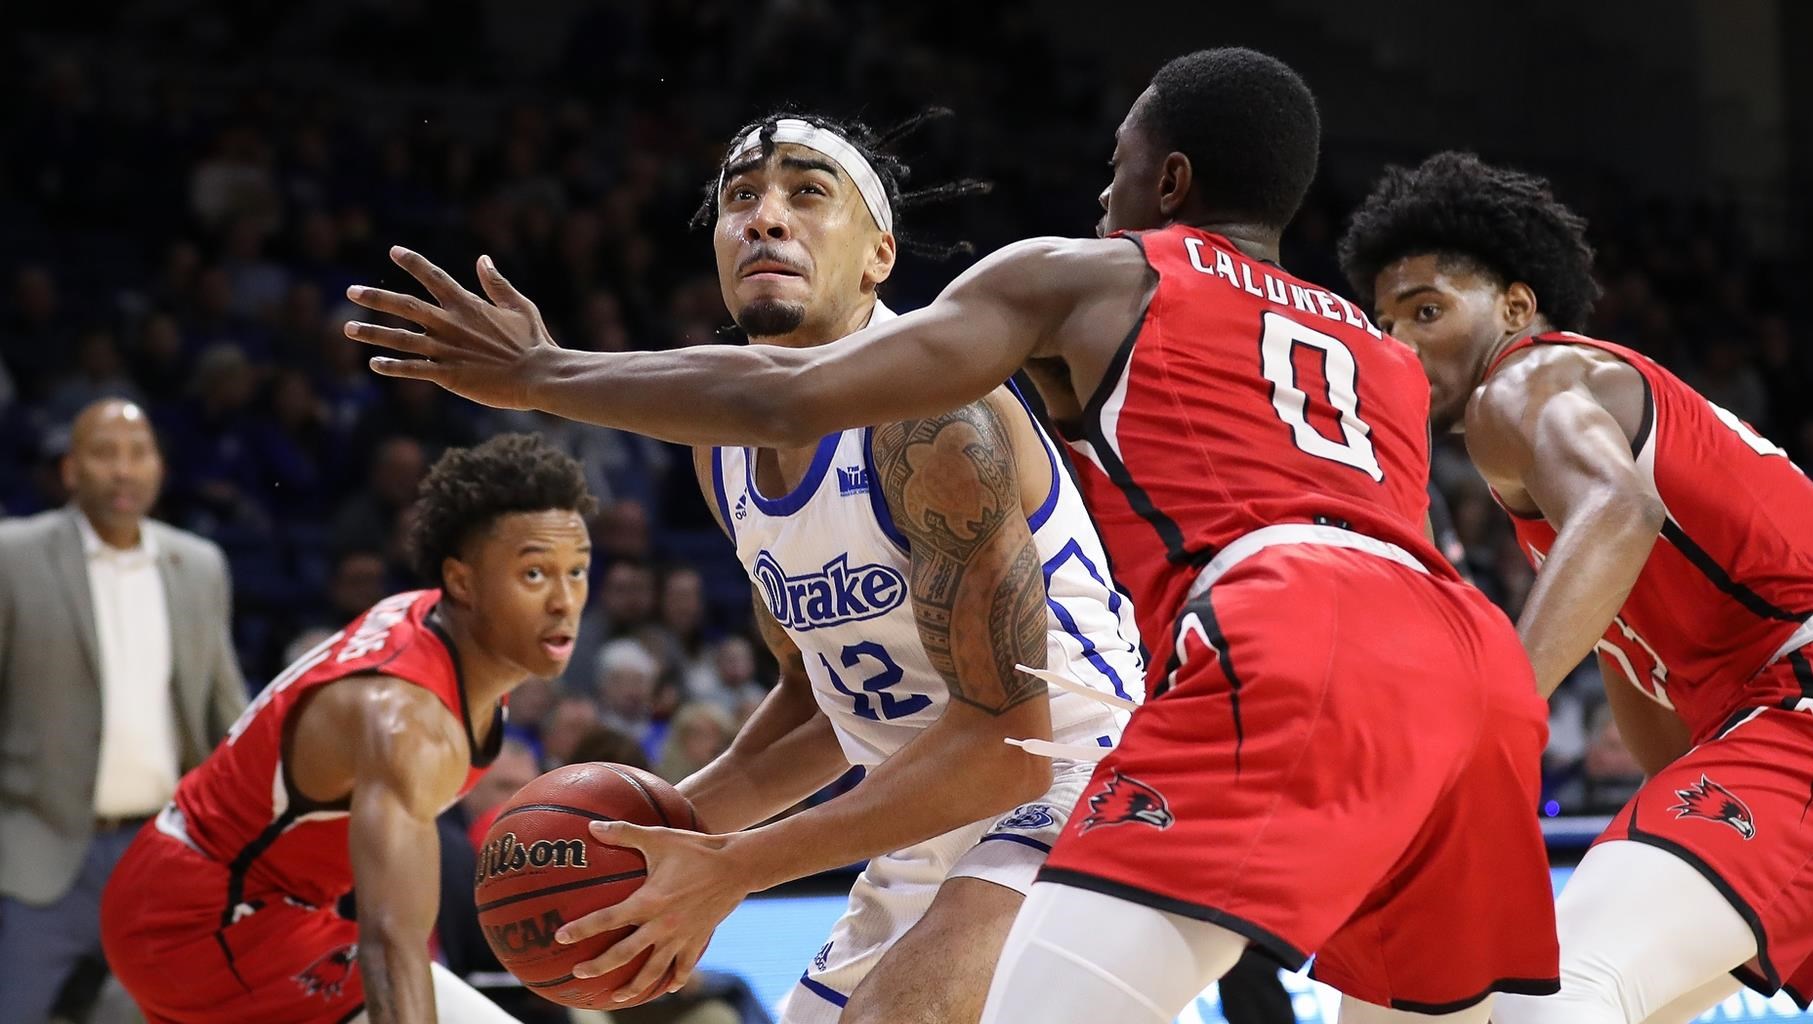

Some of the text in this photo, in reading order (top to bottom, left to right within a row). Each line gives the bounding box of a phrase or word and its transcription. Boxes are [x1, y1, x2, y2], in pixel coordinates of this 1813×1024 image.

[1259, 309, 1385, 484] 0
[754, 549, 908, 632] Drake
[817, 640, 933, 721] 12
